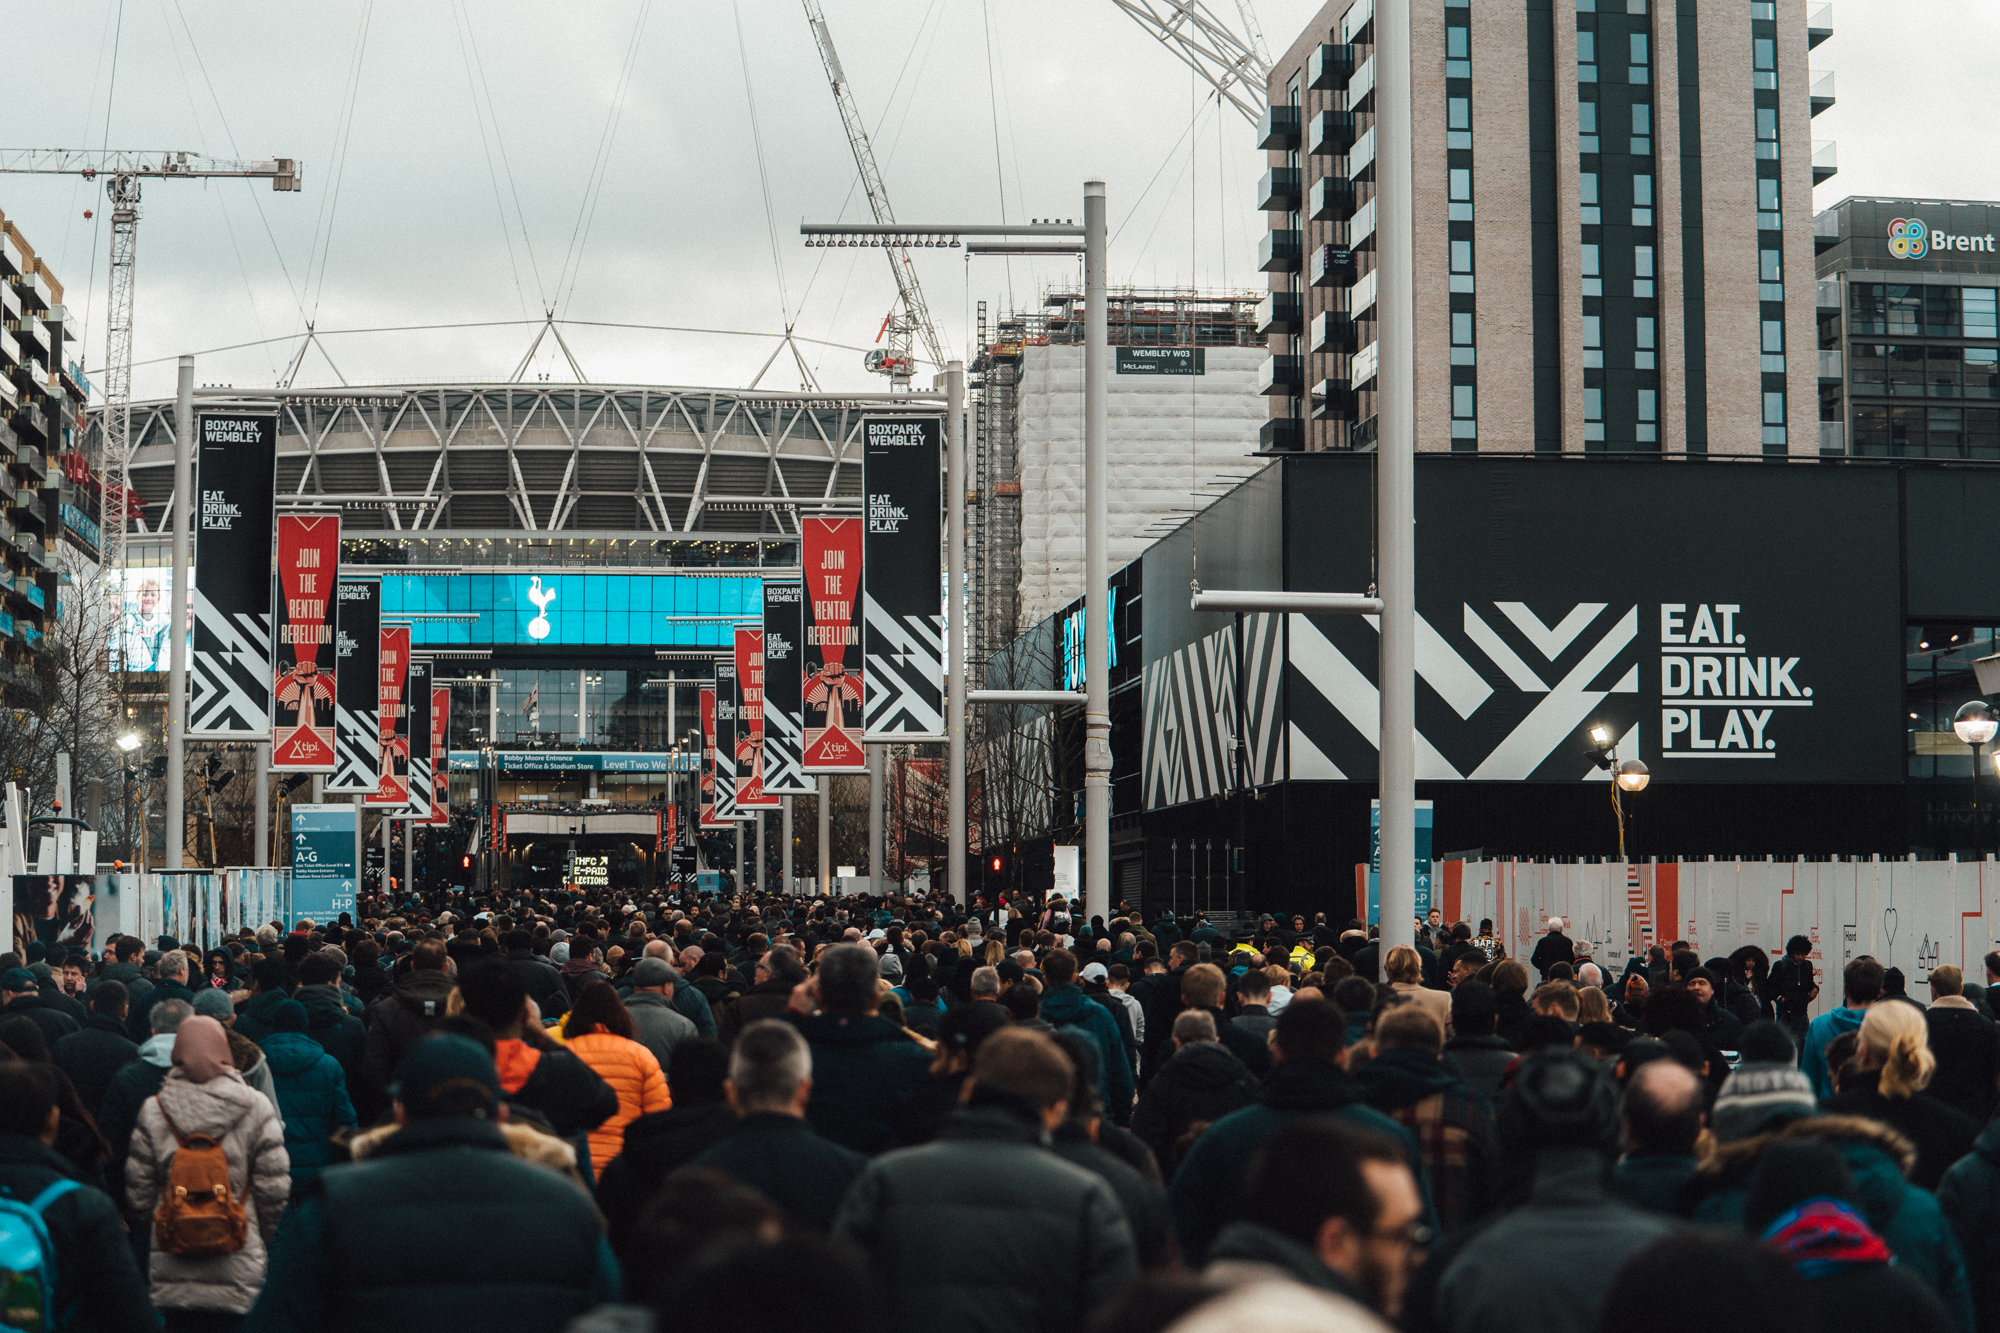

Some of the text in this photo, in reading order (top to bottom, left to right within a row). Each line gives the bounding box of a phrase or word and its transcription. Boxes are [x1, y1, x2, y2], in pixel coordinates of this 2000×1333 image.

[1931, 230, 1996, 252] Brent
[1132, 349, 1171, 357] WEMBLEY
[205, 420, 259, 432] BOXPARK
[868, 424, 922, 435] BOXPARK
[205, 431, 262, 443] WEMBLEY
[869, 435, 926, 446] WEMBLEY
[203, 490, 225, 501] EAT.
[869, 494, 892, 505] EAT.
[203, 503, 242, 515] DRINK.
[869, 507, 909, 518] DRINK.
[202, 516, 232, 528] PLAY.
[869, 520, 899, 531] PLAY.
[296, 548, 320, 568] JOIN
[821, 550, 845, 569] JOIN
[299, 573, 317, 593] THE
[824, 575, 842, 595] THE
[338, 585, 369, 593] OXPARK
[766, 587, 803, 595] BOXPARK
[338, 592, 371, 600] EMBLEY
[288, 599, 326, 619] RENTAL
[815, 600, 852, 620] RENTAL
[1660, 603, 1746, 645] EAT.
[138, 628, 157, 636] AIA
[281, 624, 333, 644] REBELLION
[767, 633, 782, 641] EAT.
[807, 626, 859, 646] REBELLION
[338, 639, 359, 647] RINK.
[1063, 586, 1118, 692] BOXK
[767, 641, 793, 649] DRINK.
[382, 668, 395, 682] THE
[1661, 656, 1813, 697] DRINK.
[380, 686, 401, 700] ENTAL
[744, 688, 763, 702] RENT
[380, 704, 406, 718] BELLION
[739, 705, 763, 720] REBELL
[1662, 708, 1776, 750] PLAY.
[504, 754, 523, 762] Bobby
[604, 760, 628, 769] Level
[629, 760, 649, 769] Two
[295, 851, 318, 862] A-G
[573, 867, 607, 875] E-PAID
[562, 876, 609, 885] CLECTIONS
[332, 898, 353, 909] H-P
[1414, 893, 1428, 903] -P
[1474, 939, 1496, 949] BAPE
